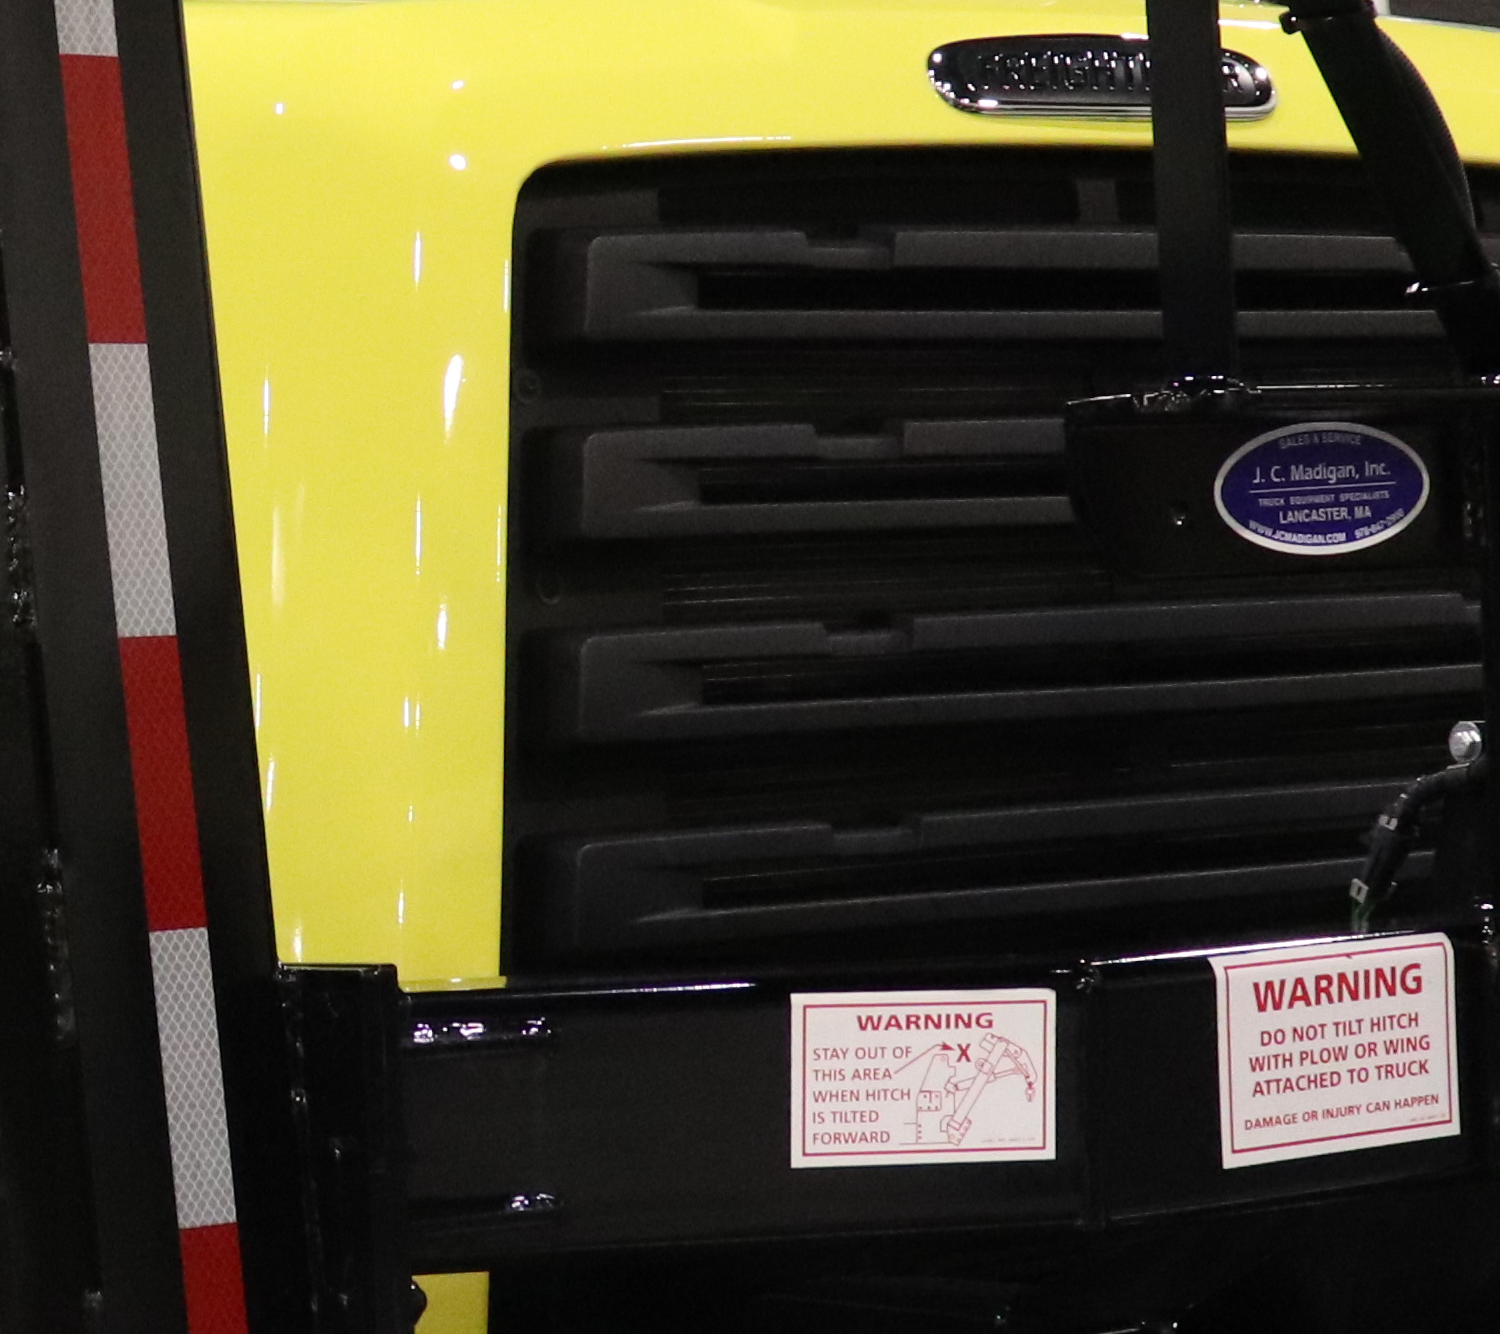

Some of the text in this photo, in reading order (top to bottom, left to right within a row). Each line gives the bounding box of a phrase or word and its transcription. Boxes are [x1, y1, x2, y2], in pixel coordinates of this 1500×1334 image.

[1278, 434, 1310, 449] SALES
[1322, 432, 1361, 445] SERVICE
[1252, 461, 1391, 484] J. C. Madigan, Inc.
[1279, 506, 1372, 524] LANCASTER, MA
[1253, 963, 1422, 1013] WARNING
[856, 1012, 994, 1032] WARNING
[1260, 1012, 1419, 1046] DO NOT TILT HITCH
[813, 1046, 912, 1061] STAY OUT OF
[956, 1043, 972, 1063] X
[1250, 1034, 1430, 1073] WITH PLOW OR WING
[813, 1068, 892, 1082] THIS AREA
[1252, 1059, 1429, 1097] ATTACHED TO TRUCK
[813, 1088, 911, 1103] WHEN HITCH
[813, 1110, 879, 1124] IS TILTED
[1244, 1094, 1439, 1131] DAMAGE OR INJURY CAN HAPPEN
[813, 1131, 890, 1145] FORWARD
